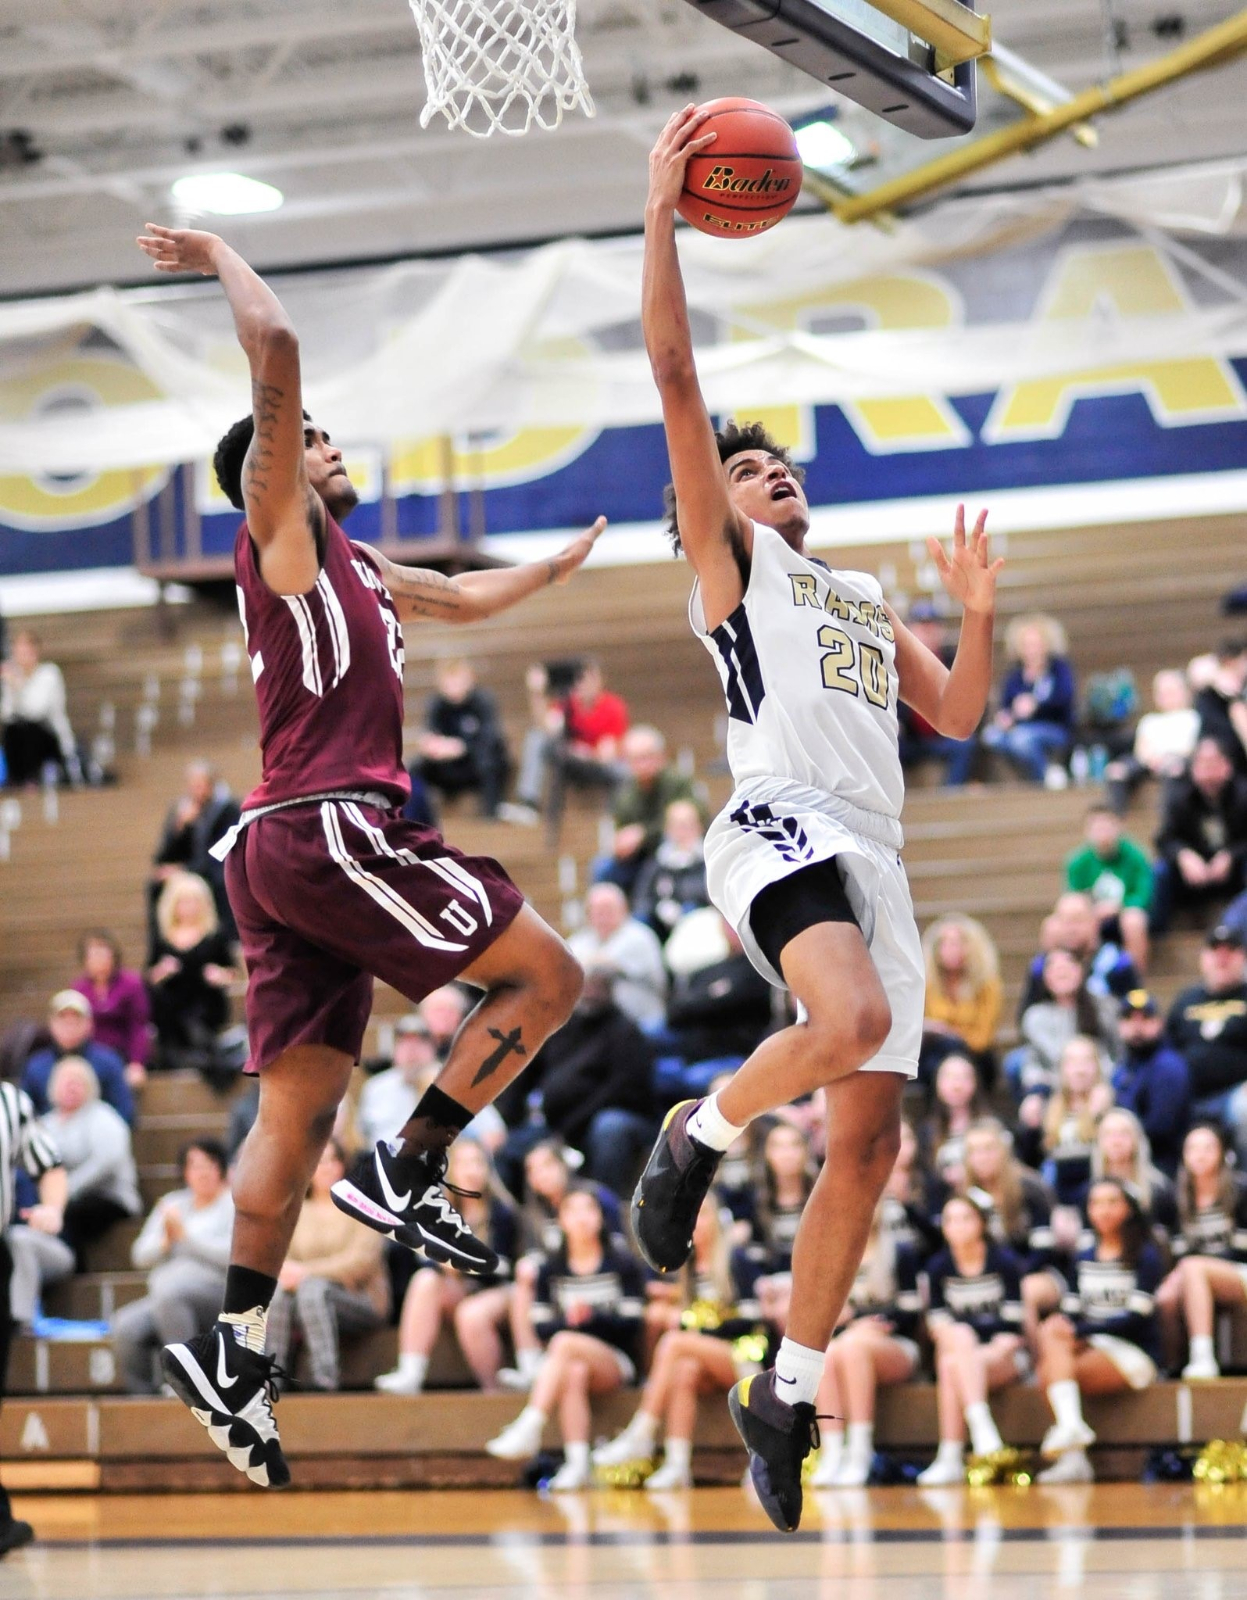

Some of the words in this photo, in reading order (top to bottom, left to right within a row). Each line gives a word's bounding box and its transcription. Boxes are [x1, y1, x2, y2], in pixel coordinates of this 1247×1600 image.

[702, 165, 791, 193] Baden
[703, 212, 780, 231] ELITE
[788, 573, 895, 644] RAMS
[816, 624, 889, 711] 20
[439, 898, 478, 937] U
[20, 1411, 50, 1451] A
